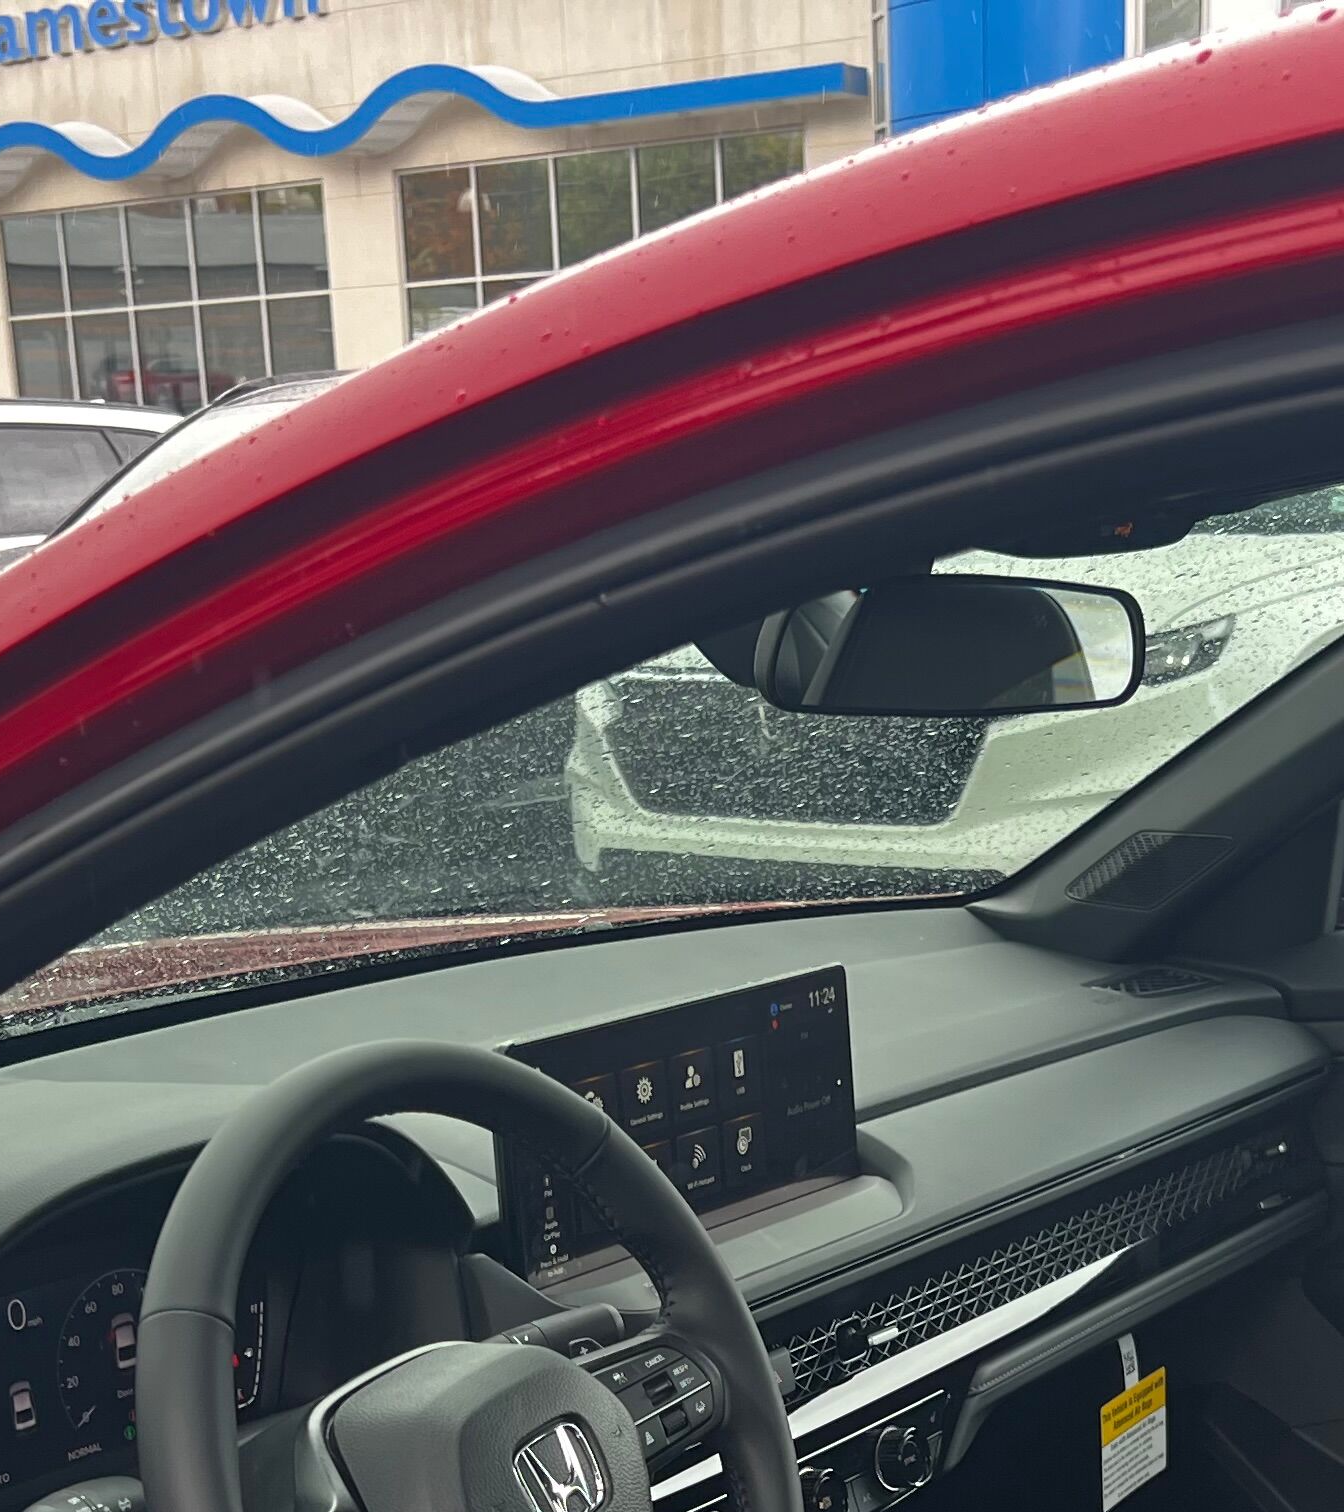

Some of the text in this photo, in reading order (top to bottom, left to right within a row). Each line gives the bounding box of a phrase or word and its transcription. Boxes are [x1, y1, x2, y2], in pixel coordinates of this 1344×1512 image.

[808, 986, 836, 1008] 11:24
[111, 1282, 124, 1296] 80
[84, 1301, 97, 1314] 60
[7, 1299, 27, 1331] 0
[68, 1335, 80, 1348] 40
[66, 1375, 79, 1389] 20
[68, 1442, 102, 1461] NORMAL
